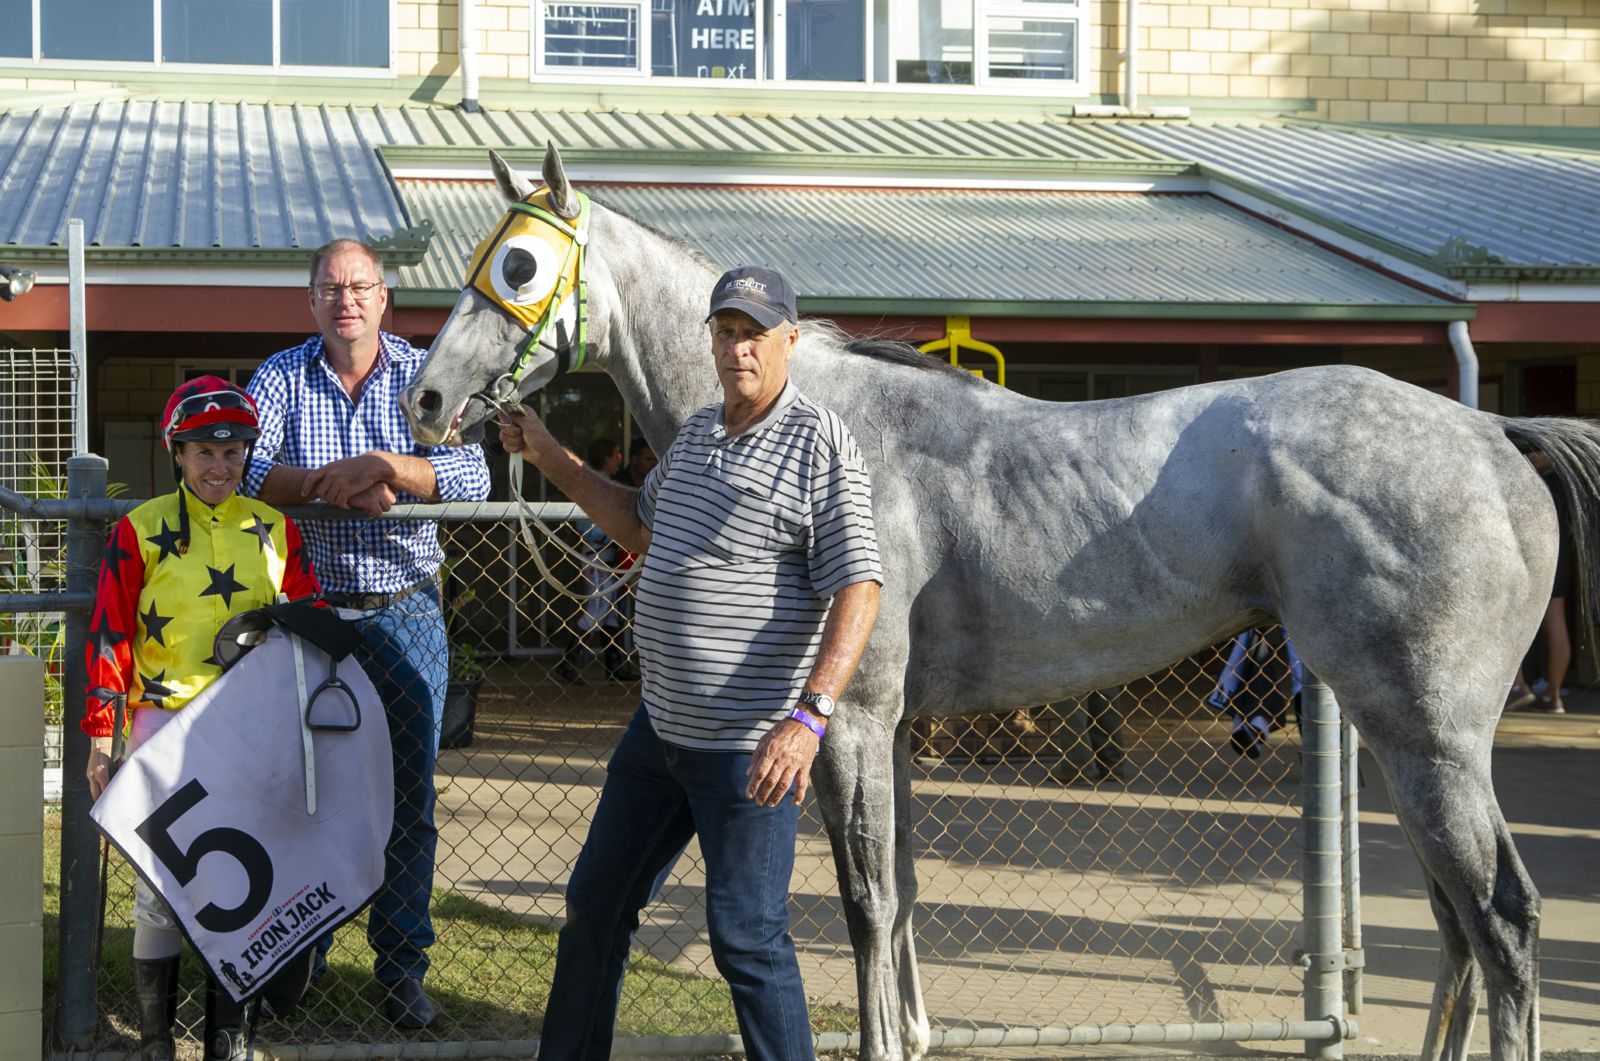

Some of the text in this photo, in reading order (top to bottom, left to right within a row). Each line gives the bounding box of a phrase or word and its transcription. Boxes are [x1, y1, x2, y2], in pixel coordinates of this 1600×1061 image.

[696, 0, 750, 16] ATM
[691, 27, 755, 50] HERE
[134, 777, 274, 933] 5
[241, 881, 337, 970] IRON JACK
[270, 912, 322, 959] AUSTRALIAN LAGERS
